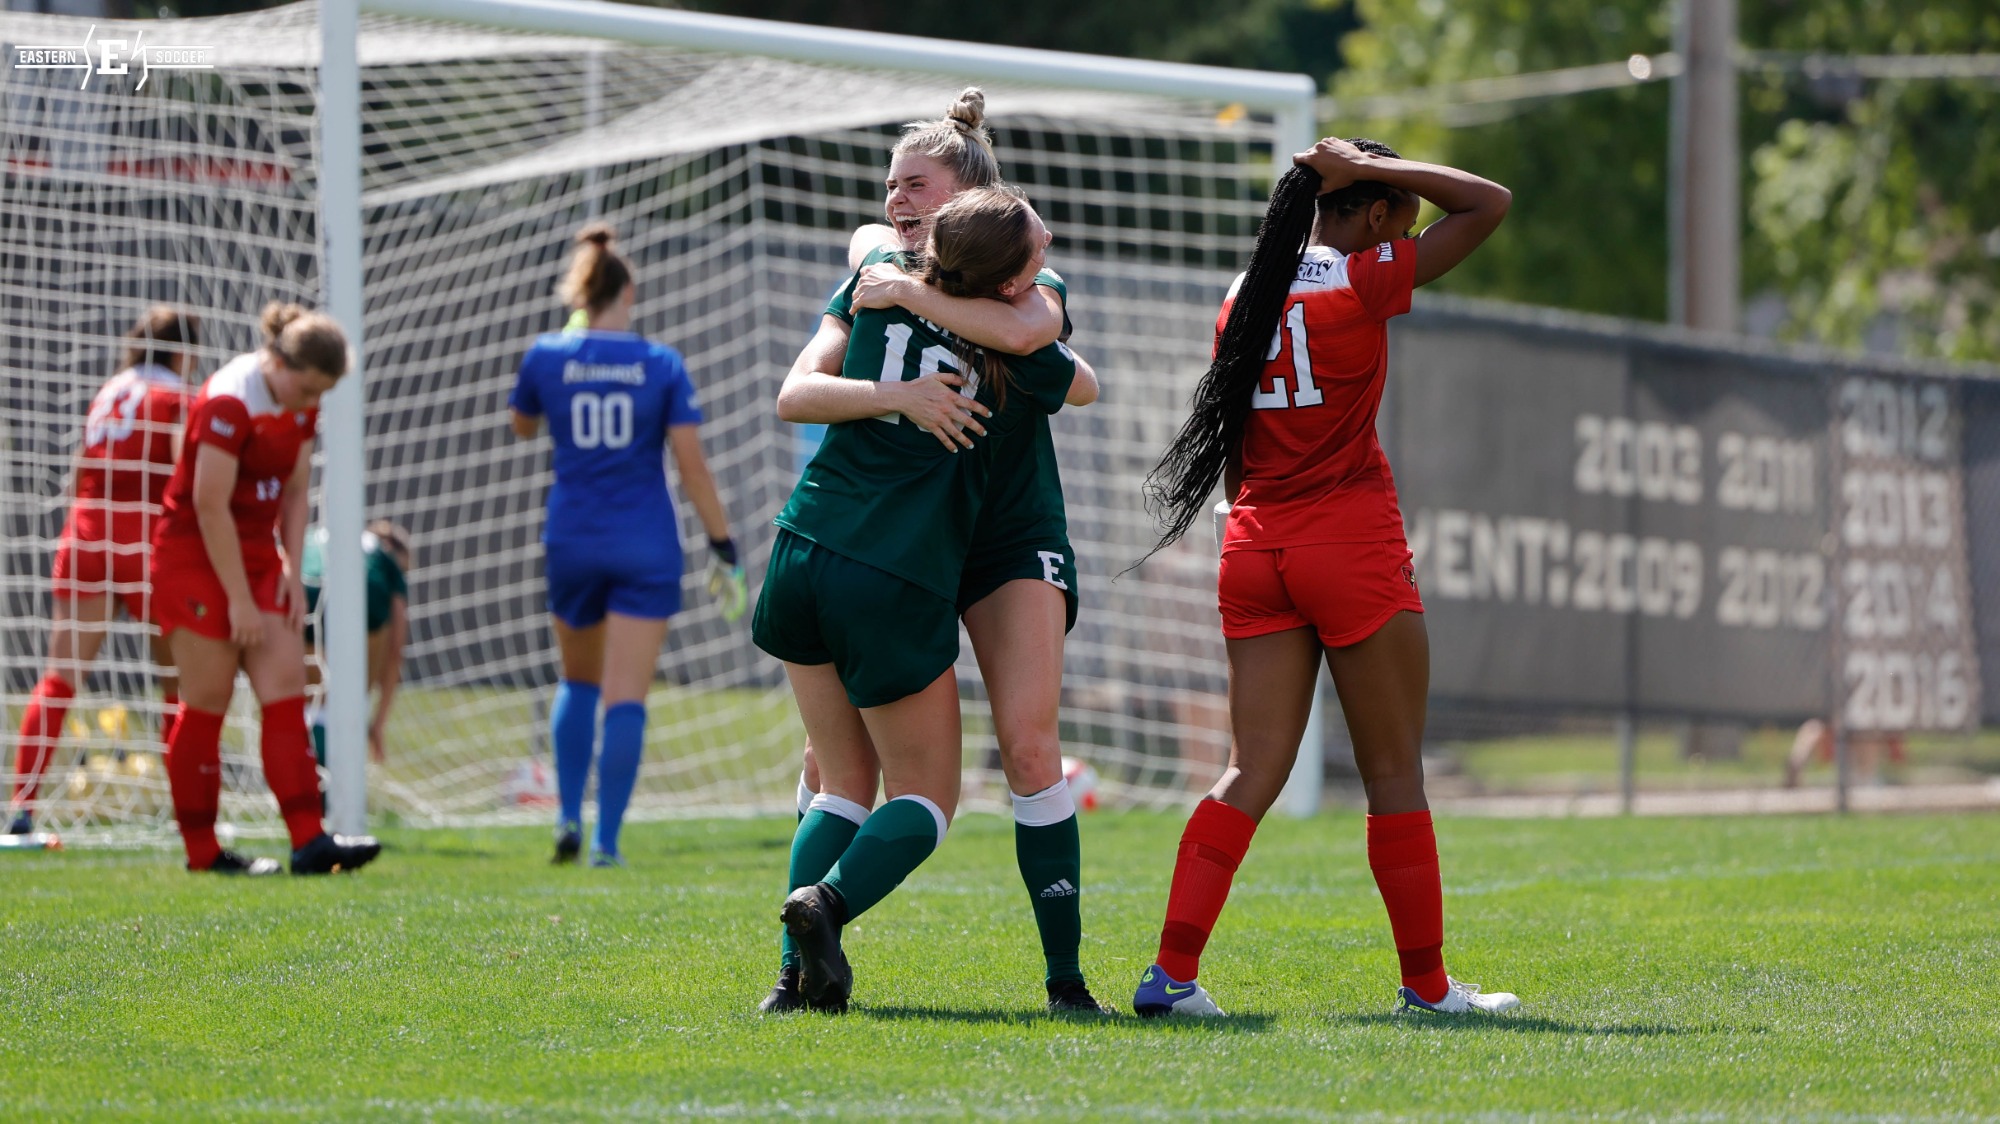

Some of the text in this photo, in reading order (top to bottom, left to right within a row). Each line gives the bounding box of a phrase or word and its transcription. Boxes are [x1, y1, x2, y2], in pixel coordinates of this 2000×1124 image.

[570, 391, 634, 449] 00
[1574, 415, 1815, 513] 2003 2011
[1037, 550, 1068, 591] E
[1573, 530, 1702, 619] 2009
[1716, 545, 1827, 631] 2012
[1040, 888, 1077, 898] adidas
